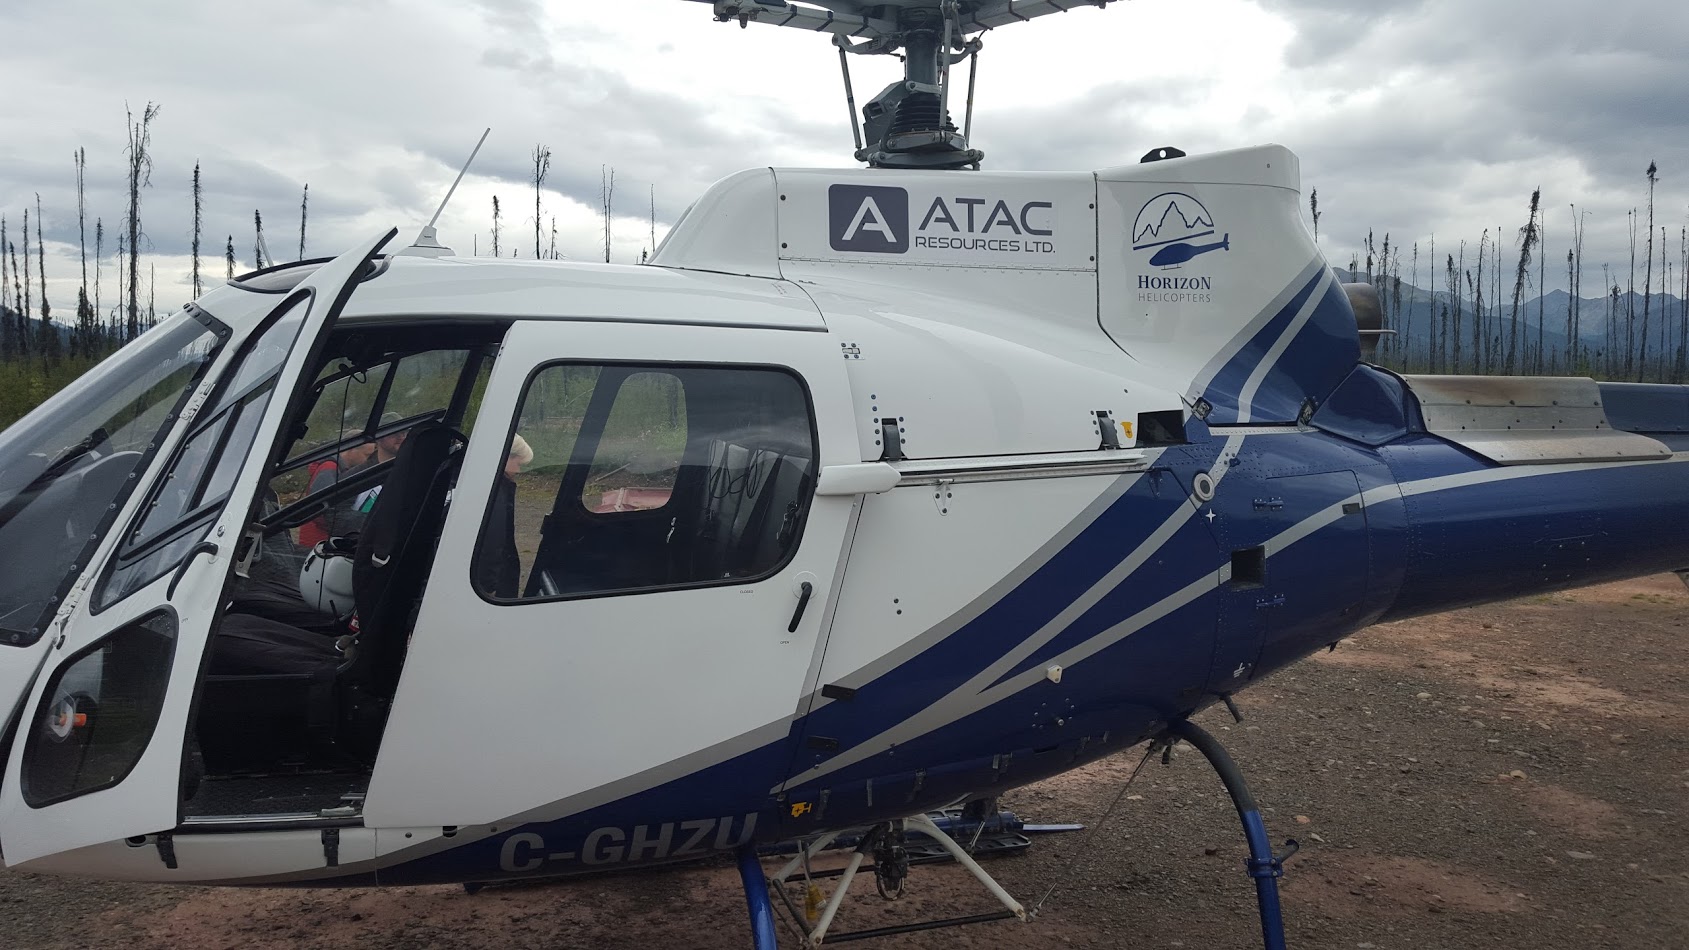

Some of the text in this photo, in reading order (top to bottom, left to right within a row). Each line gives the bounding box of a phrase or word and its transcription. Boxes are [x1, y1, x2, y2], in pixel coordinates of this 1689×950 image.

[918, 197, 1052, 237] ATAC
[915, 236, 1056, 254] RESOURCES LTD.
[1138, 275, 1211, 290] HORIZON
[1138, 293, 1211, 303] HELICOPTERS
[500, 812, 759, 872] C-GHZU
